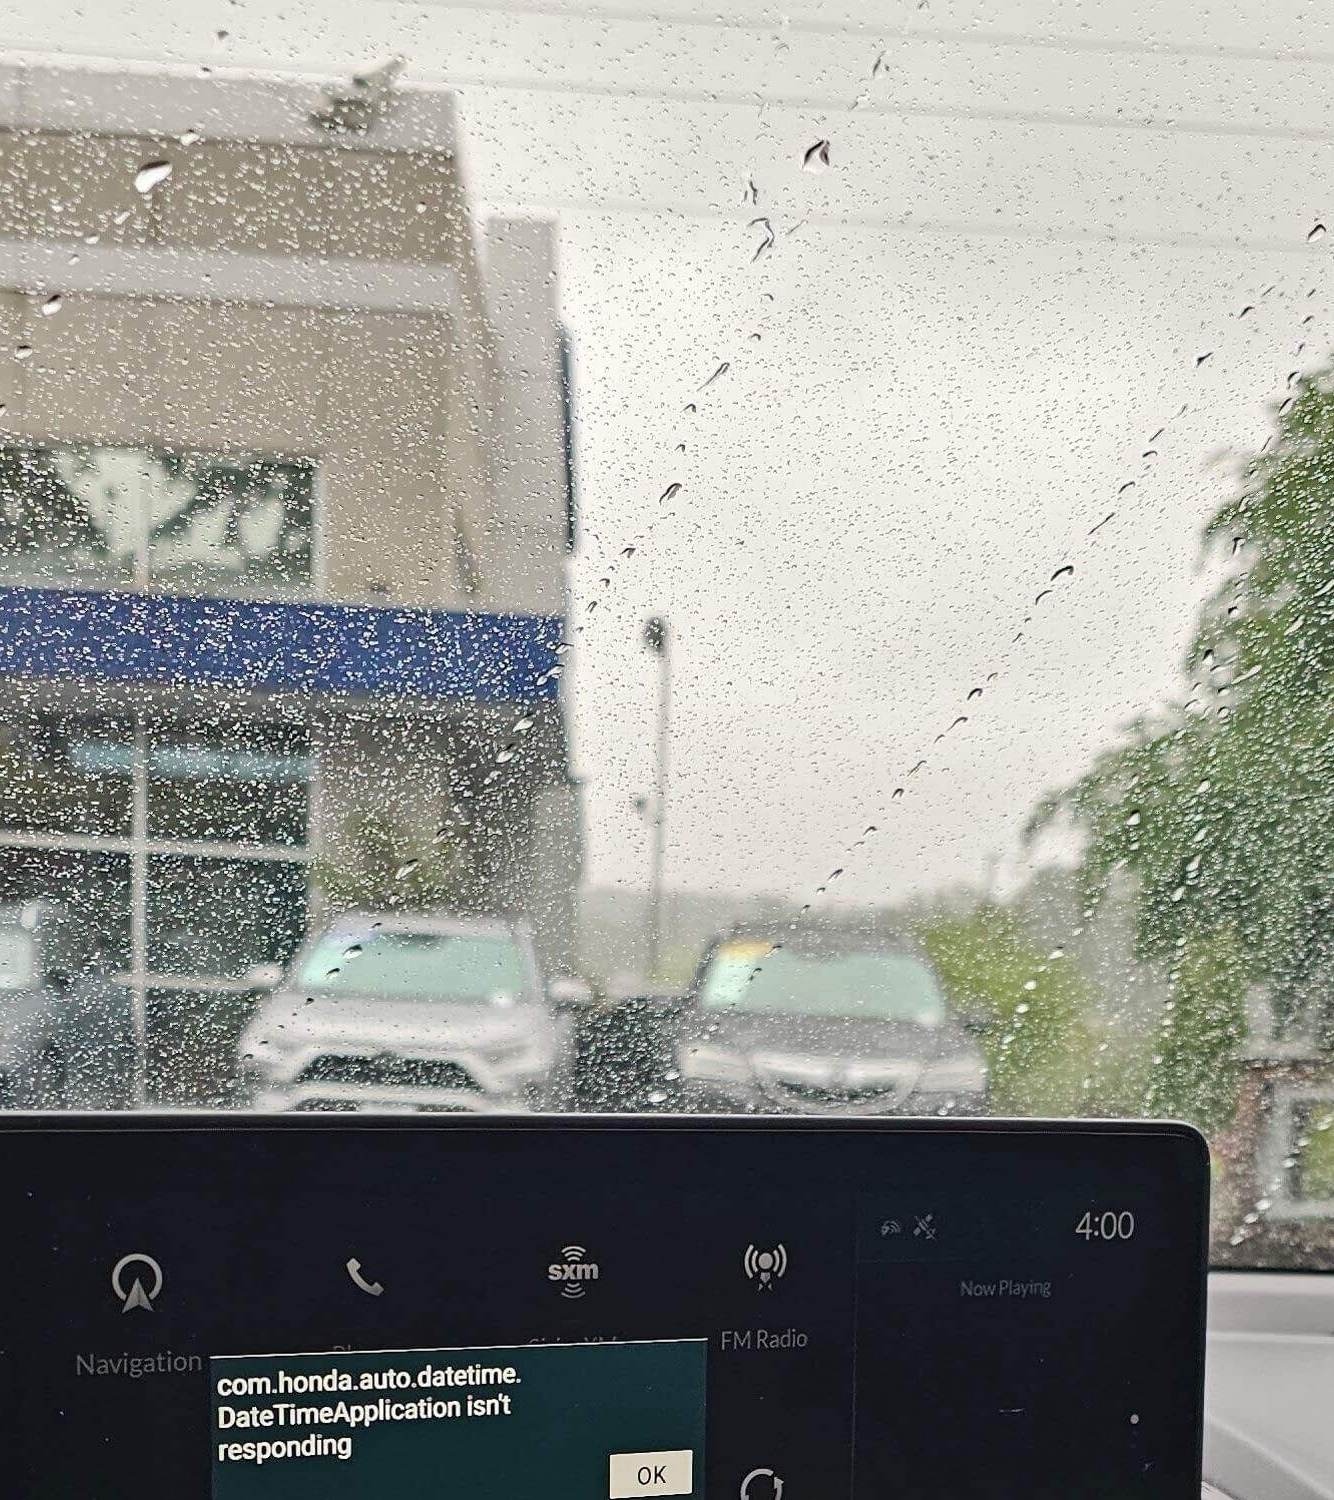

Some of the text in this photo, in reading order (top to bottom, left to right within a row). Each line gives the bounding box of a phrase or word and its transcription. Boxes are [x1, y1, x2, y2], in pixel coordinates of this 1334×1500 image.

[1075, 1211, 1135, 1241] 4:00
[547, 1262, 599, 1281] sxm
[960, 1279, 1052, 1299] Now Playing
[721, 1328, 808, 1350] FM Radio
[76, 1350, 202, 1377] Navigation
[217, 1364, 522, 1397] com.honda.auto.datetime.
[218, 1393, 512, 1430] DateTimeApplication isn't
[218, 1434, 352, 1465] responding
[637, 1466, 667, 1486] OK
